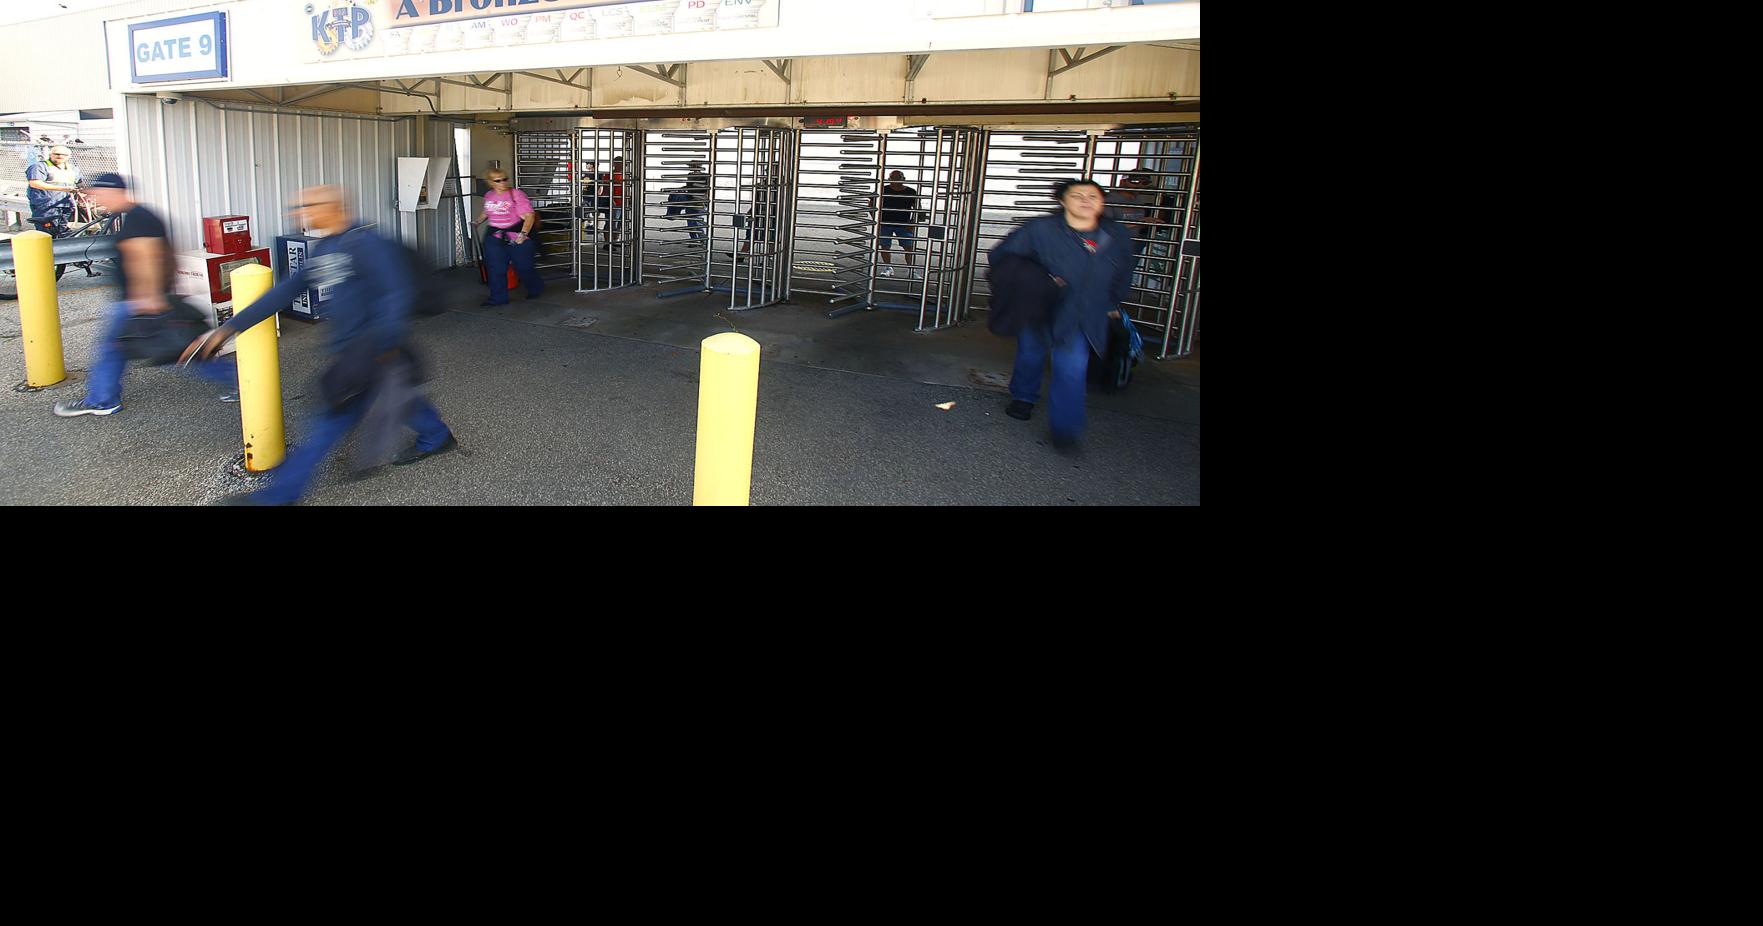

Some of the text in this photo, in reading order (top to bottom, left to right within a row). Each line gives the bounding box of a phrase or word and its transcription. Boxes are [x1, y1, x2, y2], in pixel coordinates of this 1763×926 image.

[687, 1, 705, 9] PD
[395, 0, 419, 20] A
[535, 15, 551, 23] PM
[569, 11, 585, 20] QC
[311, 6, 369, 43] KTP
[471, 21, 486, 29] AM
[136, 34, 212, 63] GATE 9
